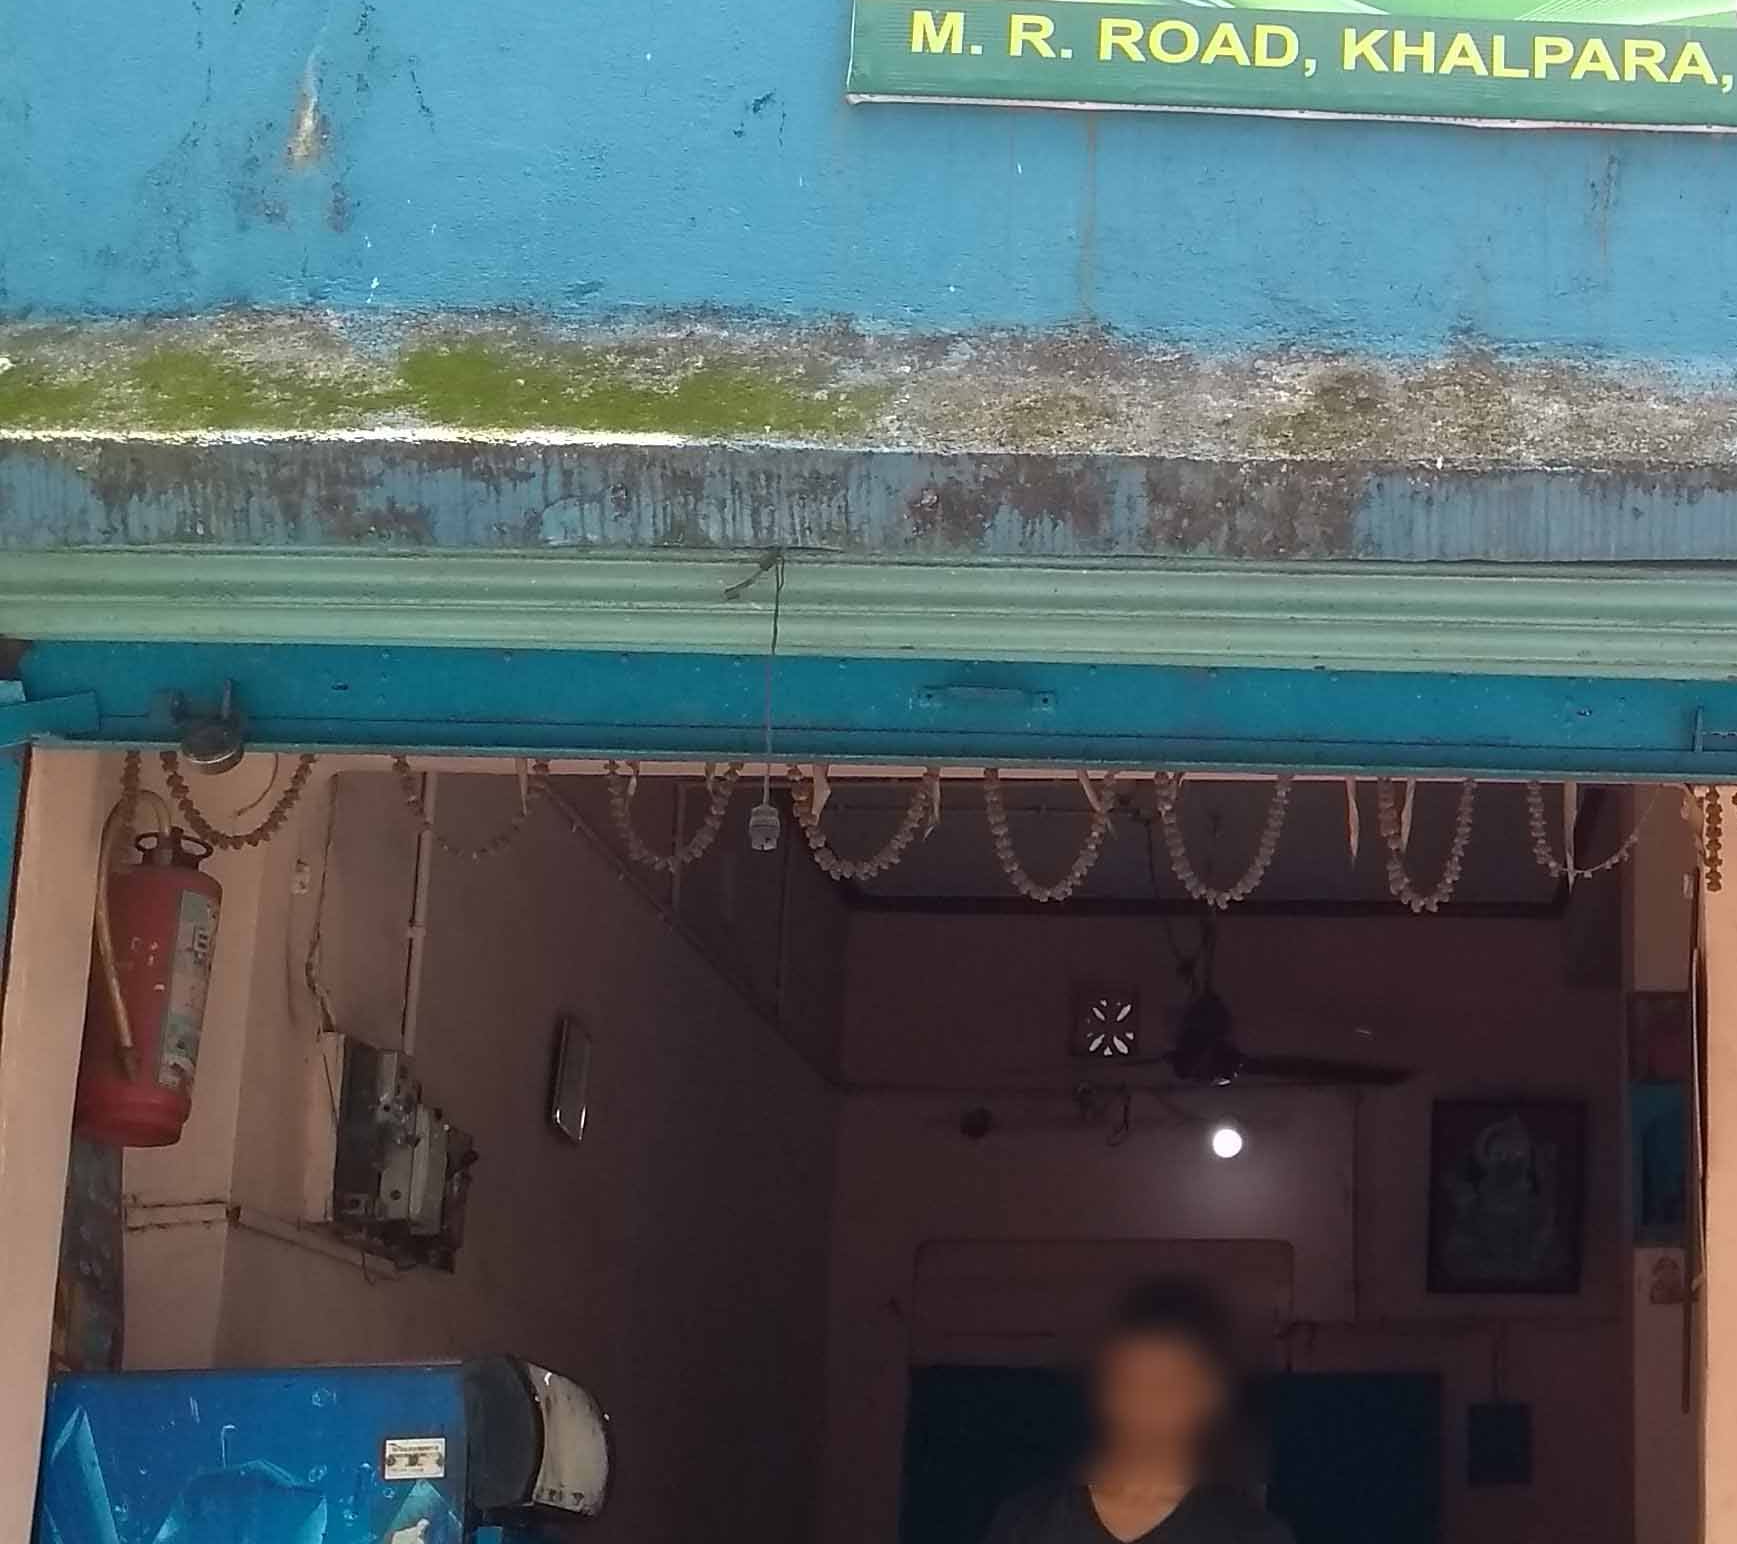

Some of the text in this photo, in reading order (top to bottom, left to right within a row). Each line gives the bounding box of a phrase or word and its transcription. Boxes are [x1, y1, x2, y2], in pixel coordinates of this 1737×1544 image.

[910, 9, 983, 55] M.
[1009, 14, 1073, 59] R.
[1099, 18, 1317, 77] ROAD,
[1343, 28, 1734, 94] KHALPARA,
